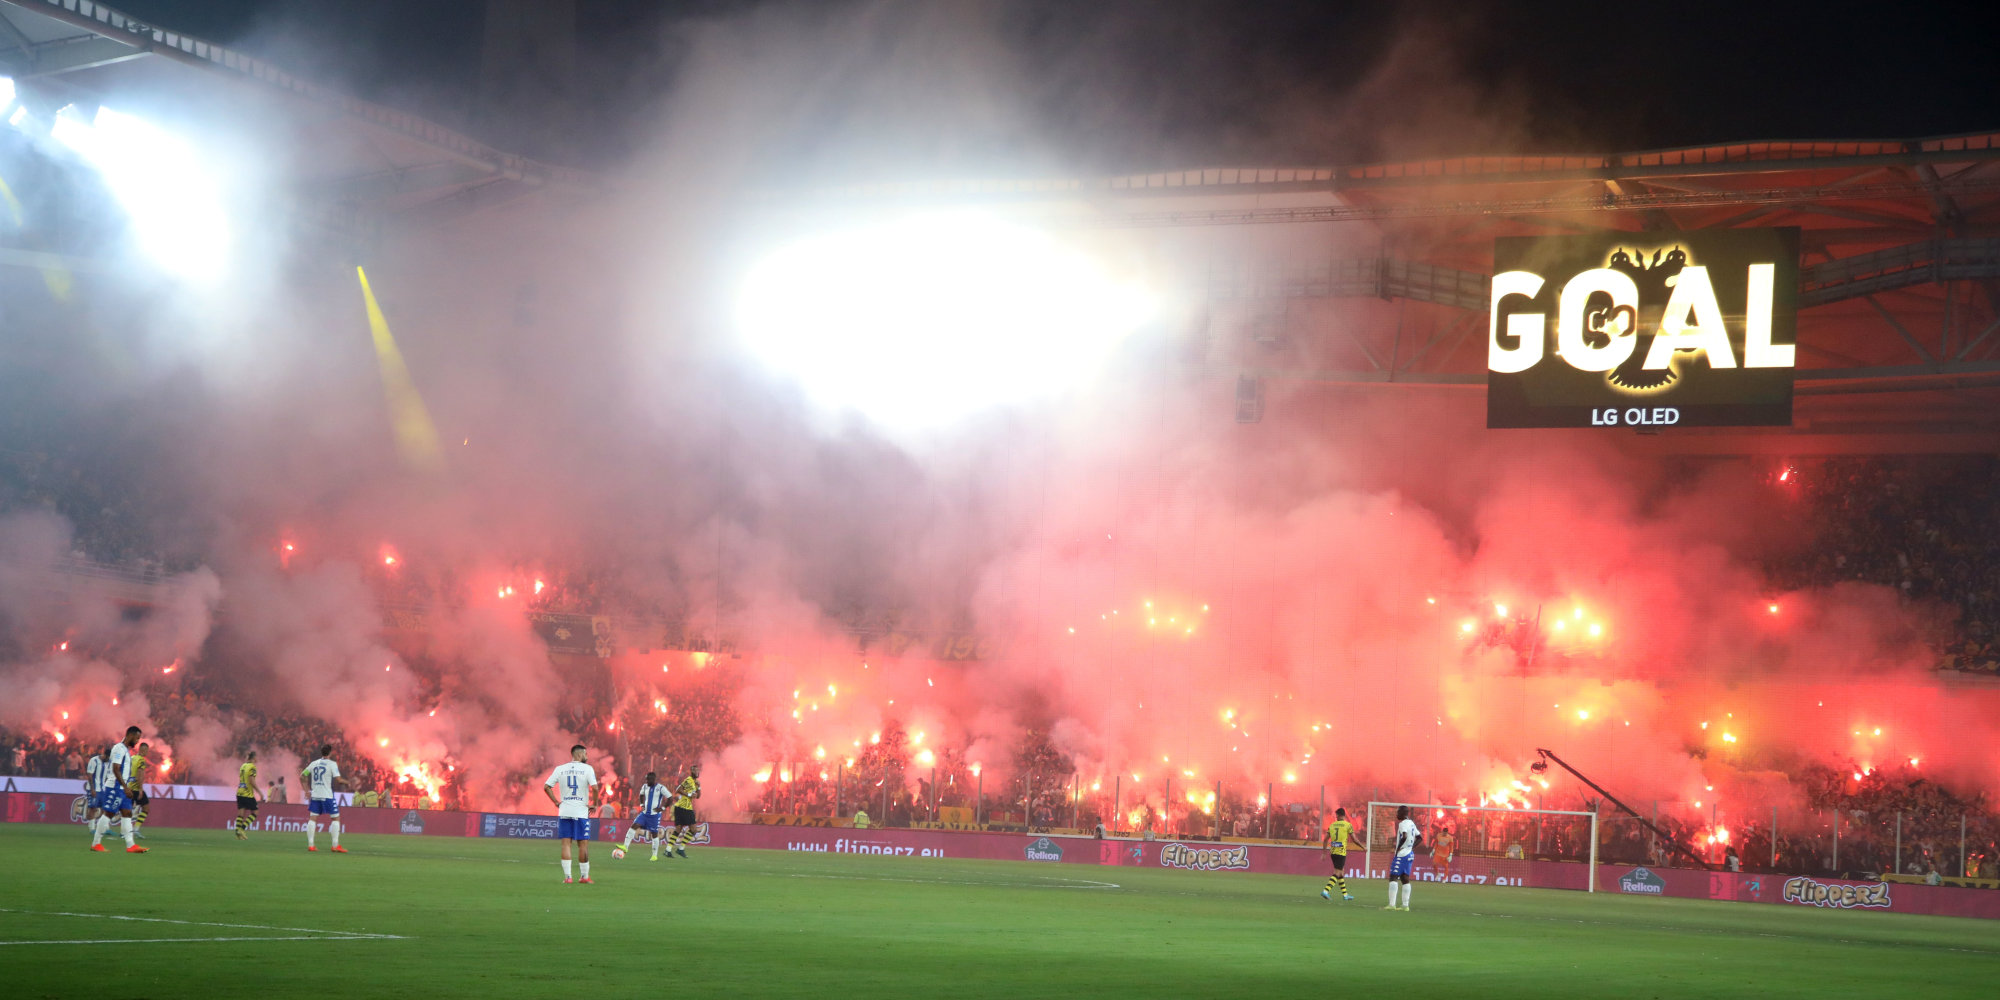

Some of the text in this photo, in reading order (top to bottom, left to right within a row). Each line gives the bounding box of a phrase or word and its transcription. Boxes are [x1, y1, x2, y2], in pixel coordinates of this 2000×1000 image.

[1488, 263, 1796, 373] GOAL
[1592, 408, 1679, 425] LG OLED
[313, 767, 327, 782] 87
[567, 775, 578, 796] 4
[498, 817, 526, 826] SUPER
[1027, 850, 1059, 861] Relkon
[1623, 881, 1660, 893] Relkon
